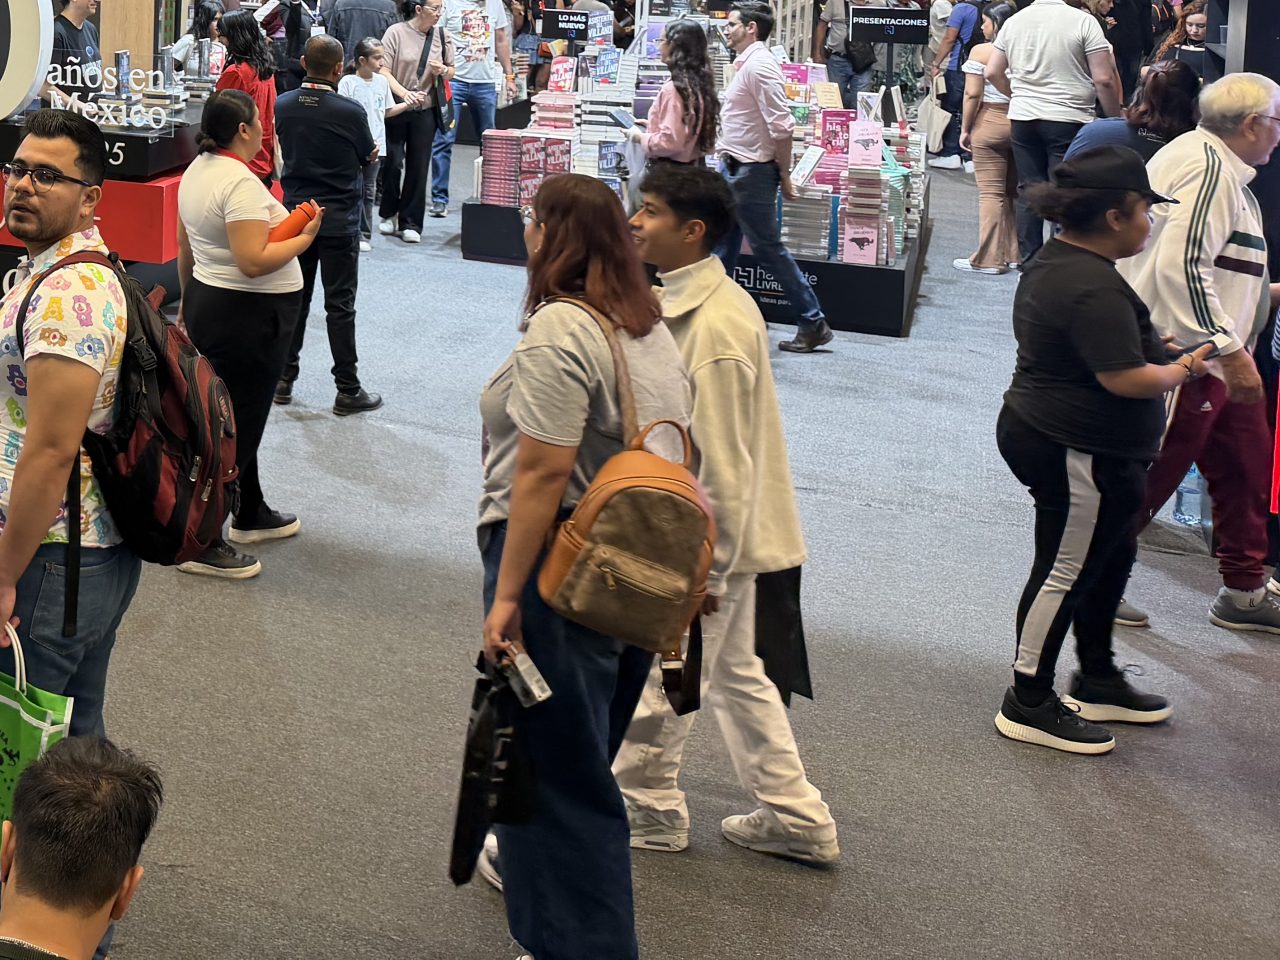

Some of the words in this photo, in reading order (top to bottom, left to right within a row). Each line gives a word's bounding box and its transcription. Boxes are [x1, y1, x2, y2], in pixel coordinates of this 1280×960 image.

[570, 14, 586, 22] MÁS
[852, 16, 928, 27] PRESENTACIONES
[46, 55, 118, 90] años
[129, 67, 166, 93] en
[47, 90, 167, 129] México
[760, 297, 777, 305] Ideas
